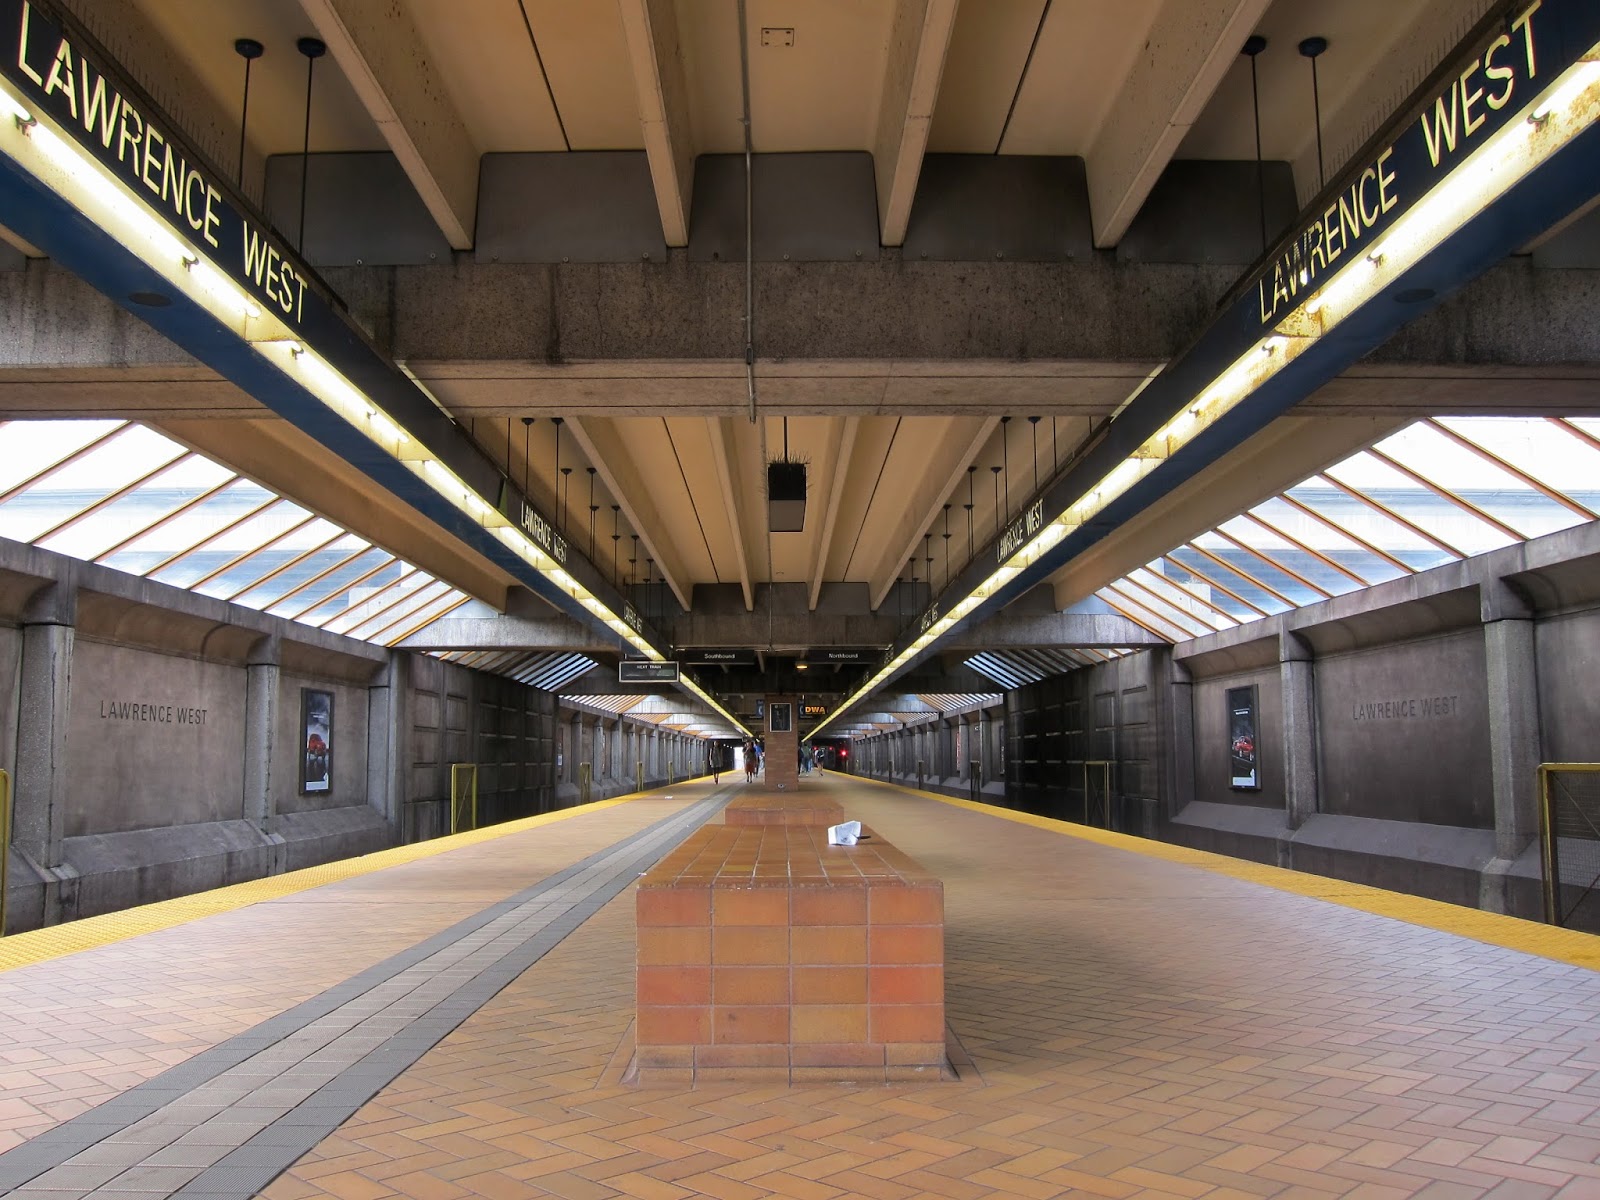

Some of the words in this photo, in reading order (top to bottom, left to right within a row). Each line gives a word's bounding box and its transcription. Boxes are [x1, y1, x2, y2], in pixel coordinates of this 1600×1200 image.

[18, 0, 222, 249] LAWRENCE
[243, 220, 308, 324] WEST
[1259, 146, 1399, 325] LAWRENCE
[1420, 0, 1542, 168] WEST
[521, 500, 552, 551] LAWRENCE
[996, 518, 1024, 563] LAWRENCE
[1025, 498, 1043, 537] WEST
[100, 700, 172, 723] LAWRENCE
[177, 707, 208, 725] WEST
[1352, 699, 1417, 721] LAWRENCE
[1420, 696, 1458, 718] WEST
